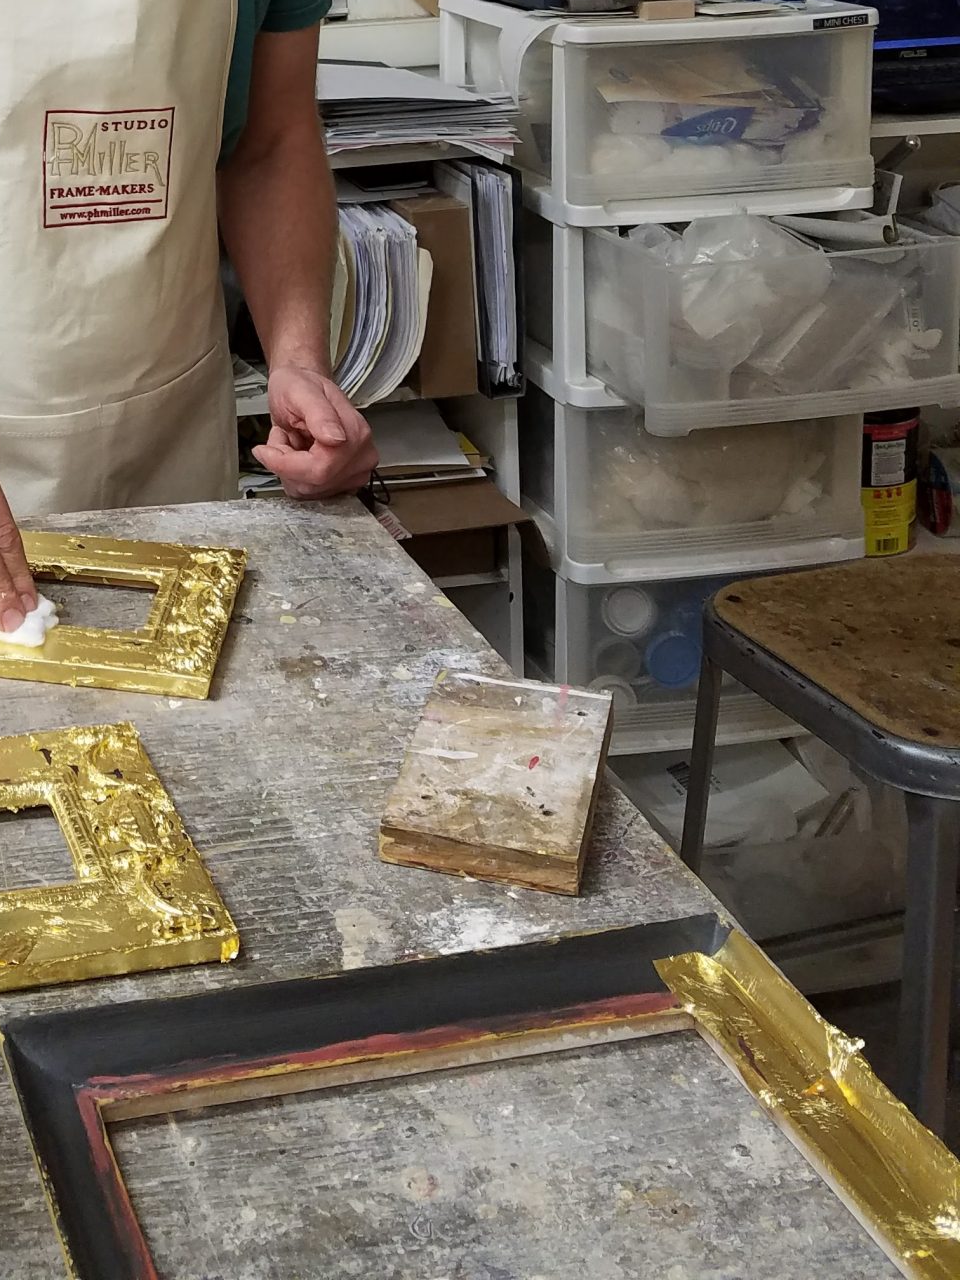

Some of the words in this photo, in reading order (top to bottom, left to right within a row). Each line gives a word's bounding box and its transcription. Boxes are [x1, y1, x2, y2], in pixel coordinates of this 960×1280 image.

[823, 18, 842, 28] MINI
[842, 15, 867, 26] CHEST
[100, 118, 169, 132] STUDIO
[49, 183, 155, 200] FRAME-MAKERS
[59, 206, 152, 221] www.phmiller.com
